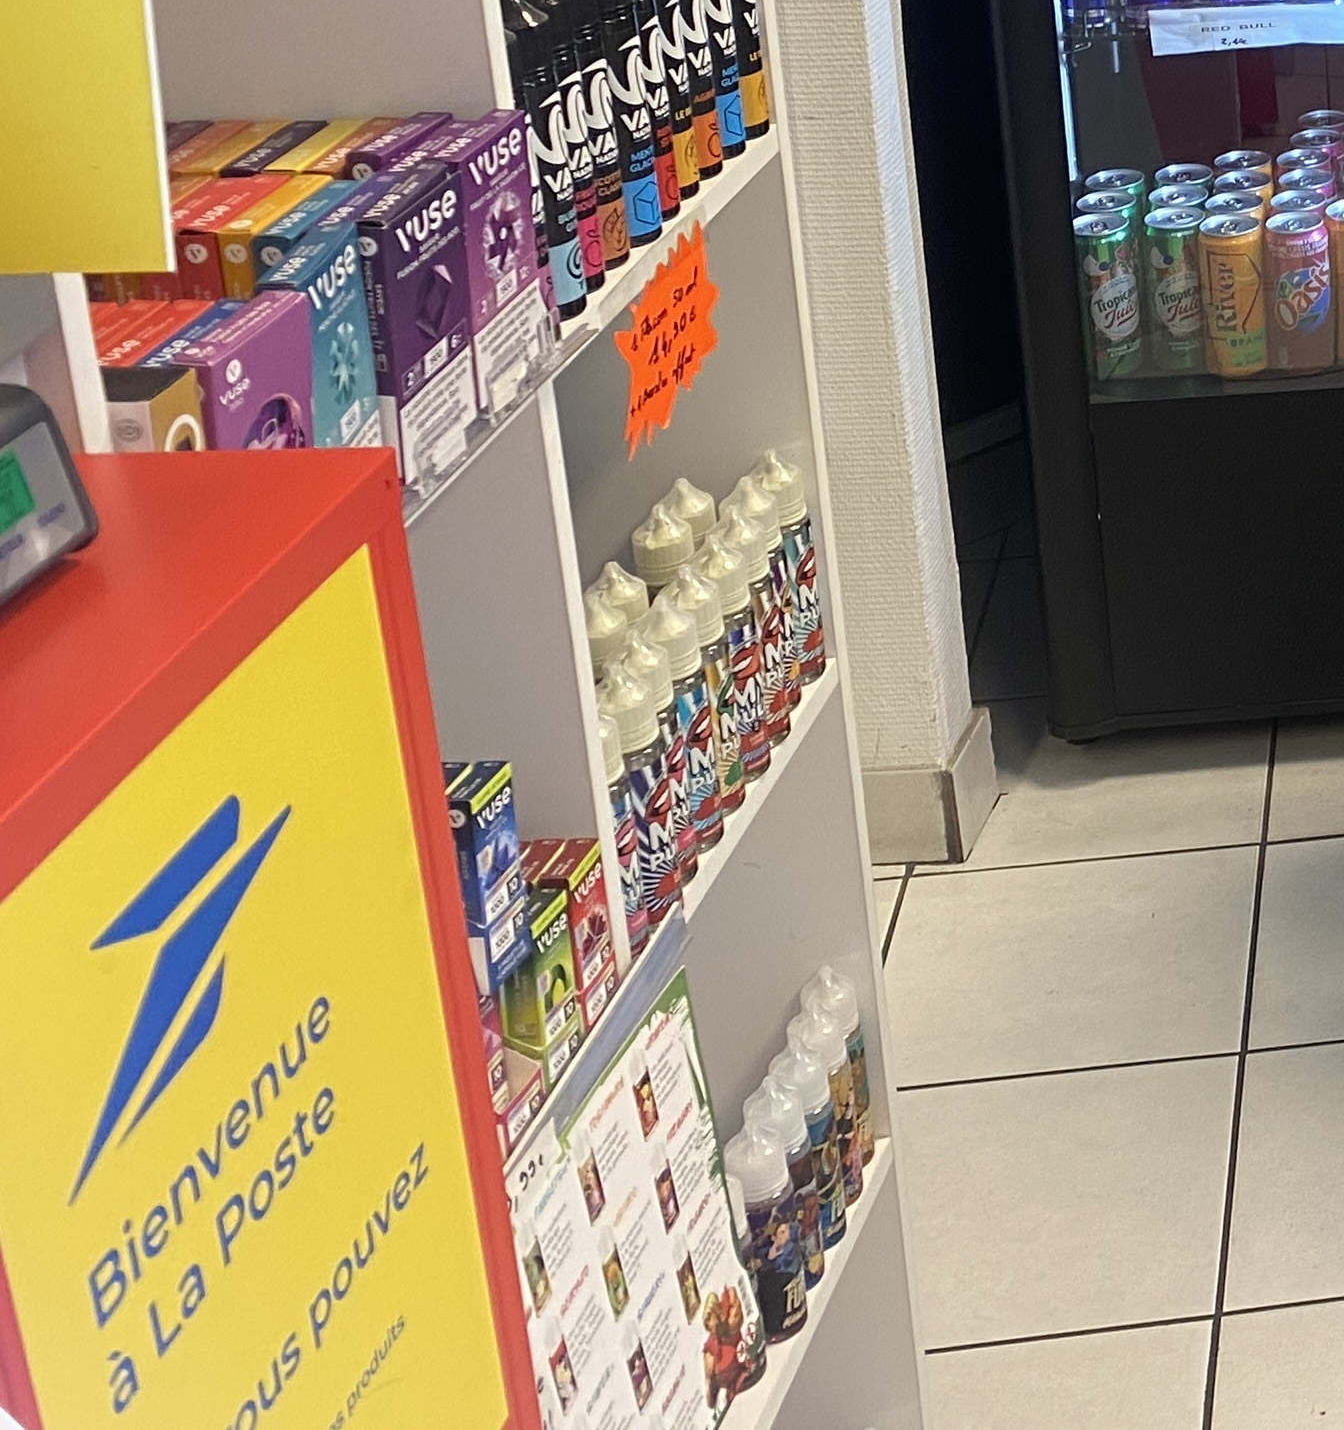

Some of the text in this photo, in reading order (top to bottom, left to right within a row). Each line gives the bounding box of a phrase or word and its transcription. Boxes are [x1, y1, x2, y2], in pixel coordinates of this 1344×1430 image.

[86, 995, 332, 1329] Bienvenue
[108, 1084, 336, 1416] à La Poste
[308, 1142, 429, 1351] pouvez
[345, 1314, 408, 1413] produits
